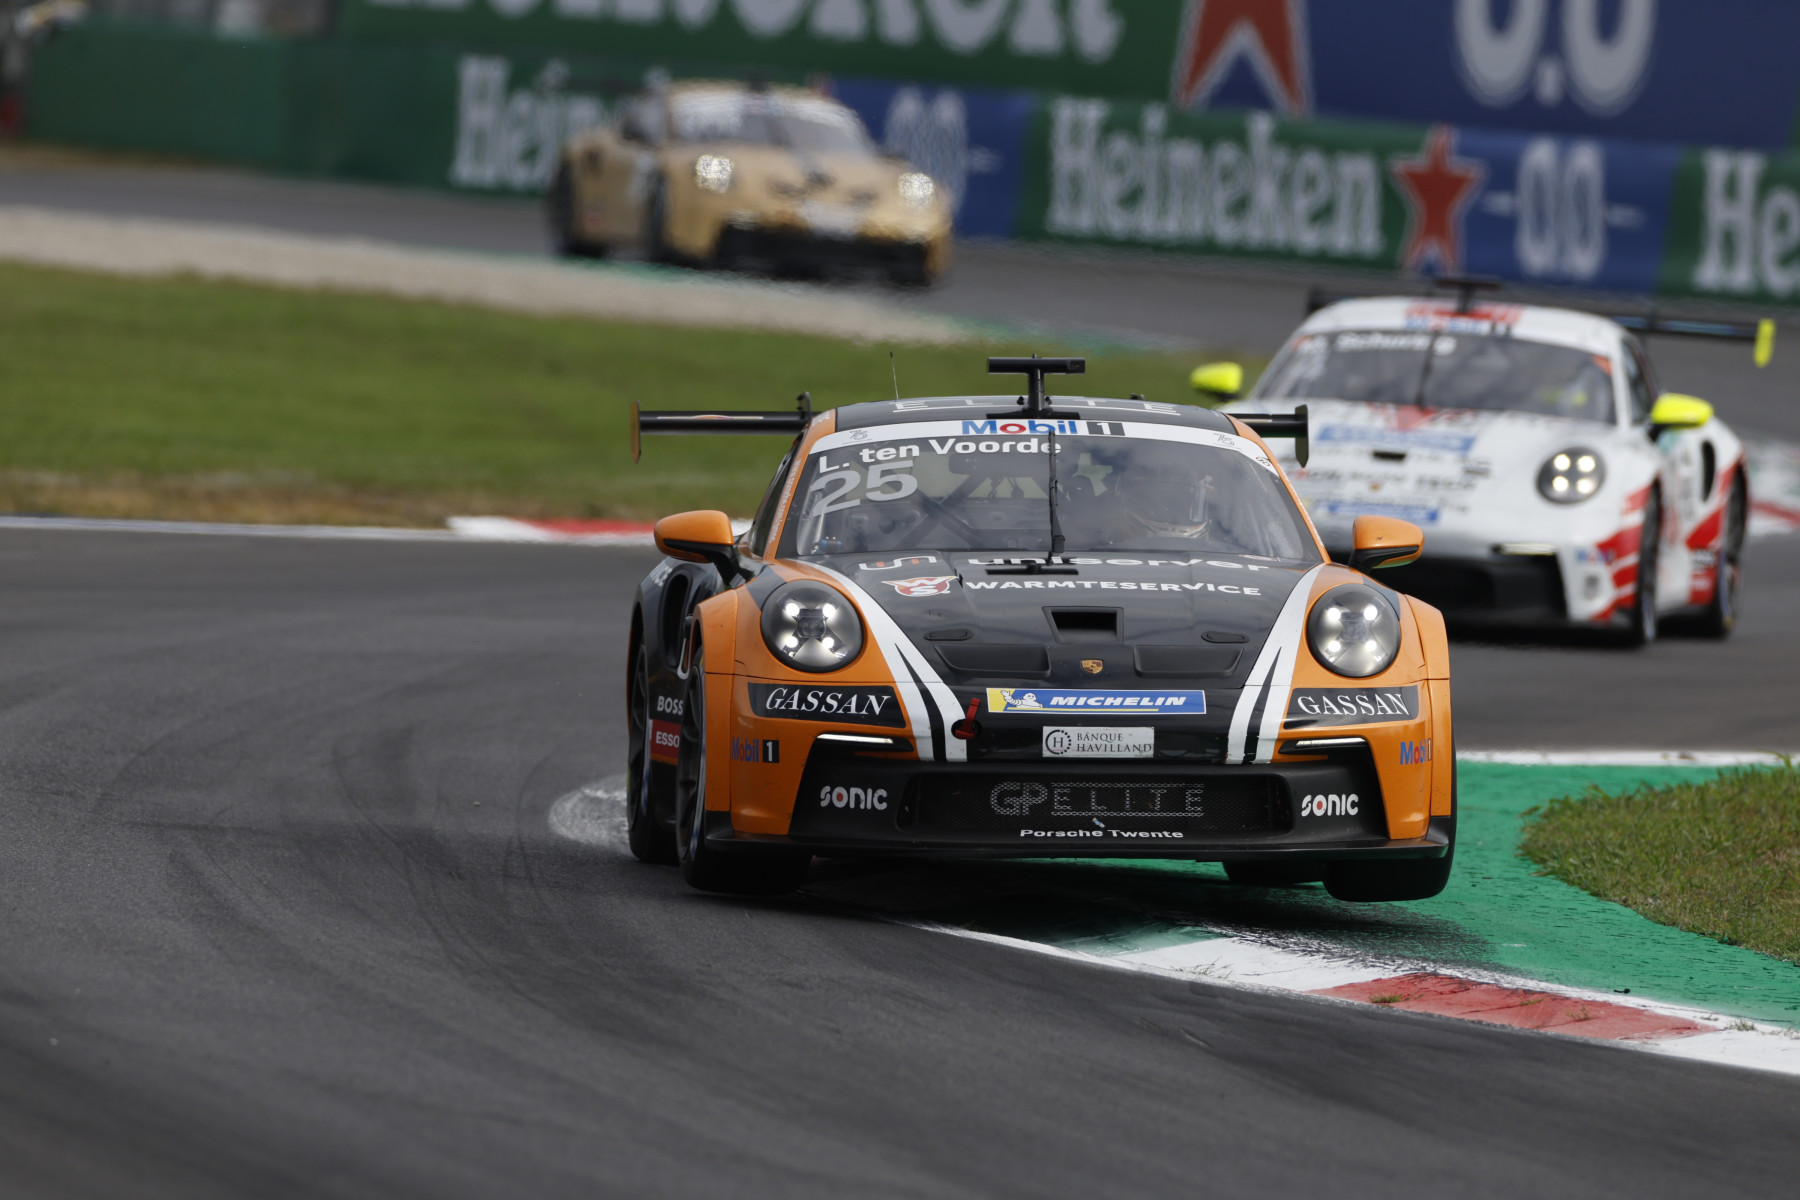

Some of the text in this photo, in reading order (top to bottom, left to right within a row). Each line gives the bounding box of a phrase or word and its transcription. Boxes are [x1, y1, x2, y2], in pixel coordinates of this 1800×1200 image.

[1048, 98, 1384, 256] Heineken
[962, 420, 1078, 435] Mobil
[819, 438, 1061, 473] L. ten Voorde
[811, 460, 918, 517] 25
[968, 556, 1269, 571] uniserver
[965, 580, 1262, 596] WARMTESERVICE
[657, 695, 684, 716] BOSS
[765, 687, 892, 716] GASSAN
[1049, 696, 1187, 706] MICHELIN
[1297, 693, 1410, 716] GASSAN
[655, 731, 680, 748] ESSO
[1077, 733, 1123, 743] BANQUE
[731, 736, 760, 763] Mobil
[1076, 743, 1152, 753] HAVILLAND
[1020, 829, 1184, 838] Porsche Twente
